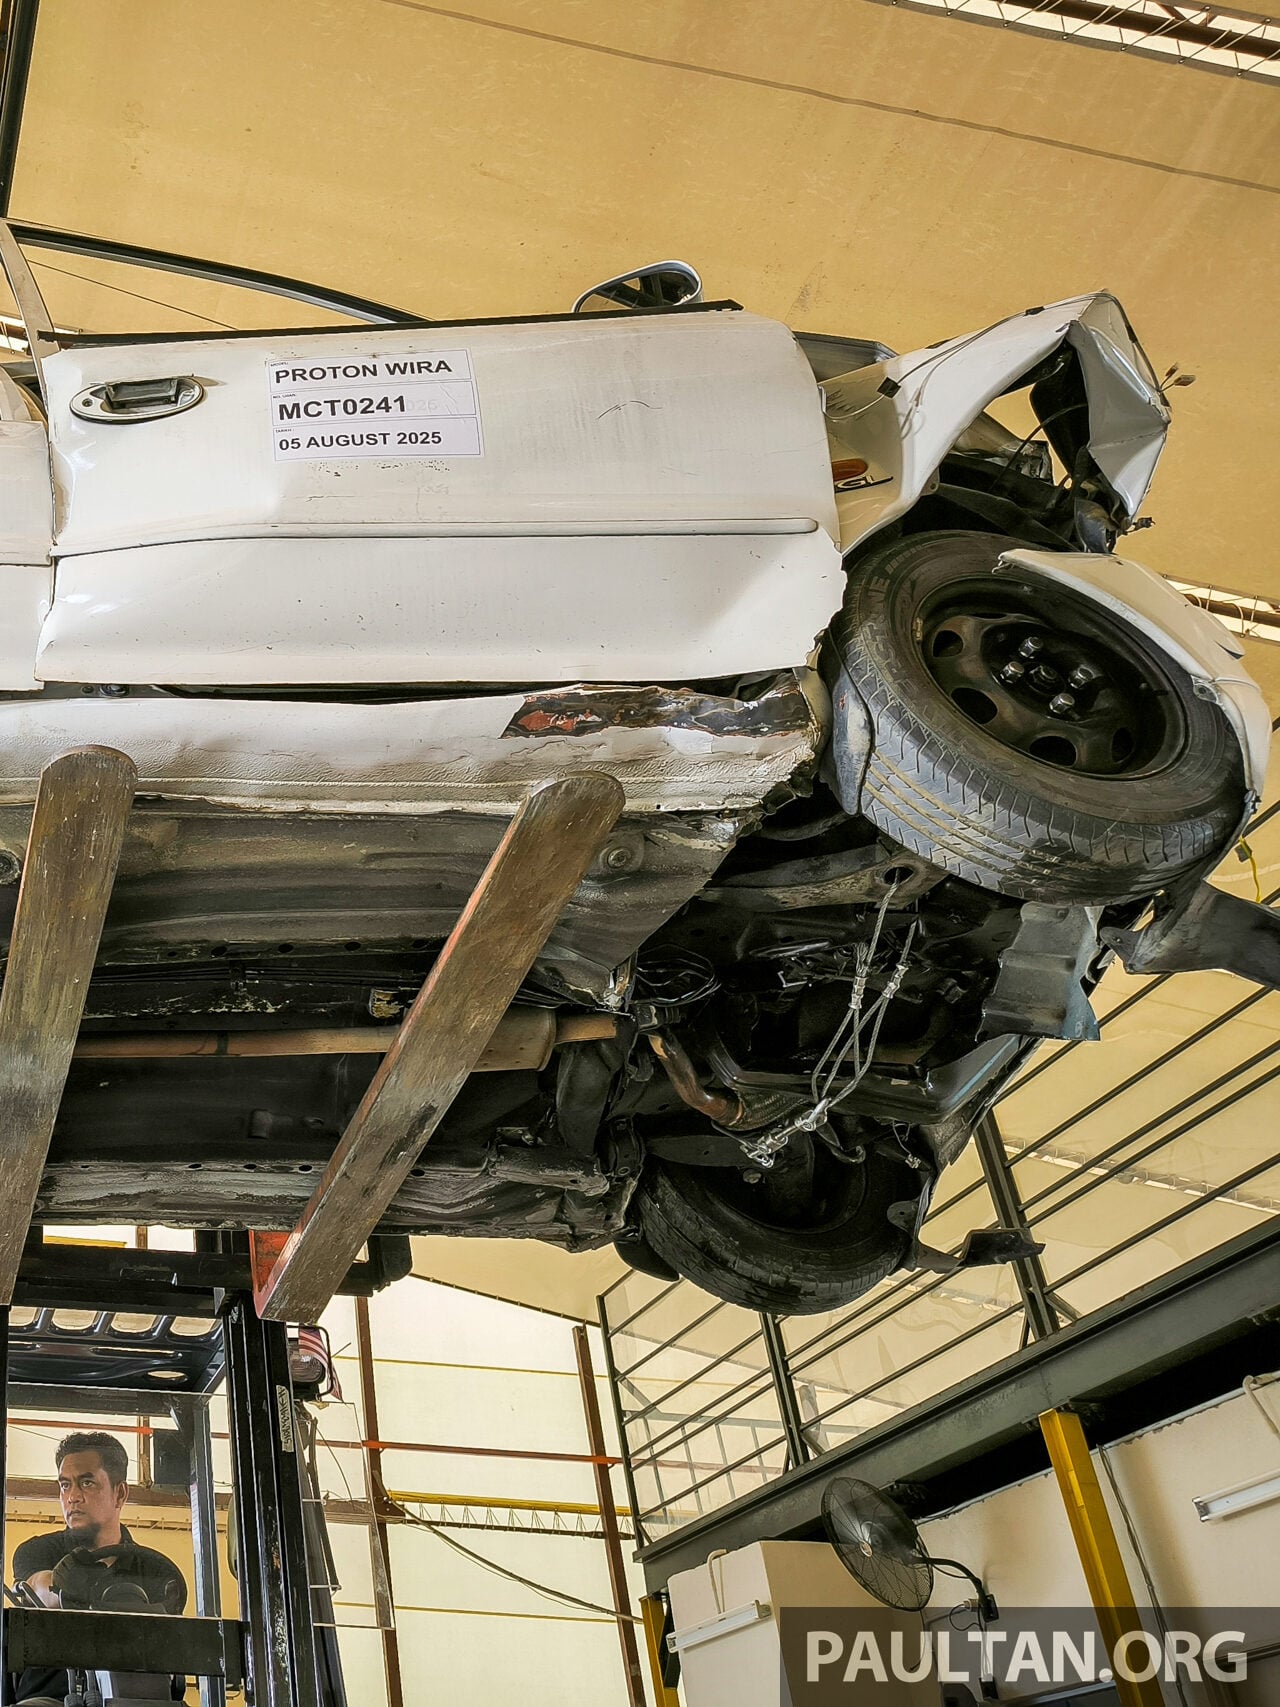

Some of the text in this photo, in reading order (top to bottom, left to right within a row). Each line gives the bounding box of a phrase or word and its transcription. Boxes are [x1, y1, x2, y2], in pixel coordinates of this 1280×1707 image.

[276, 360, 453, 383] PROTON WIRA
[278, 395, 406, 421] MCT0241
[279, 431, 442, 451] 05 AUGUST 2025
